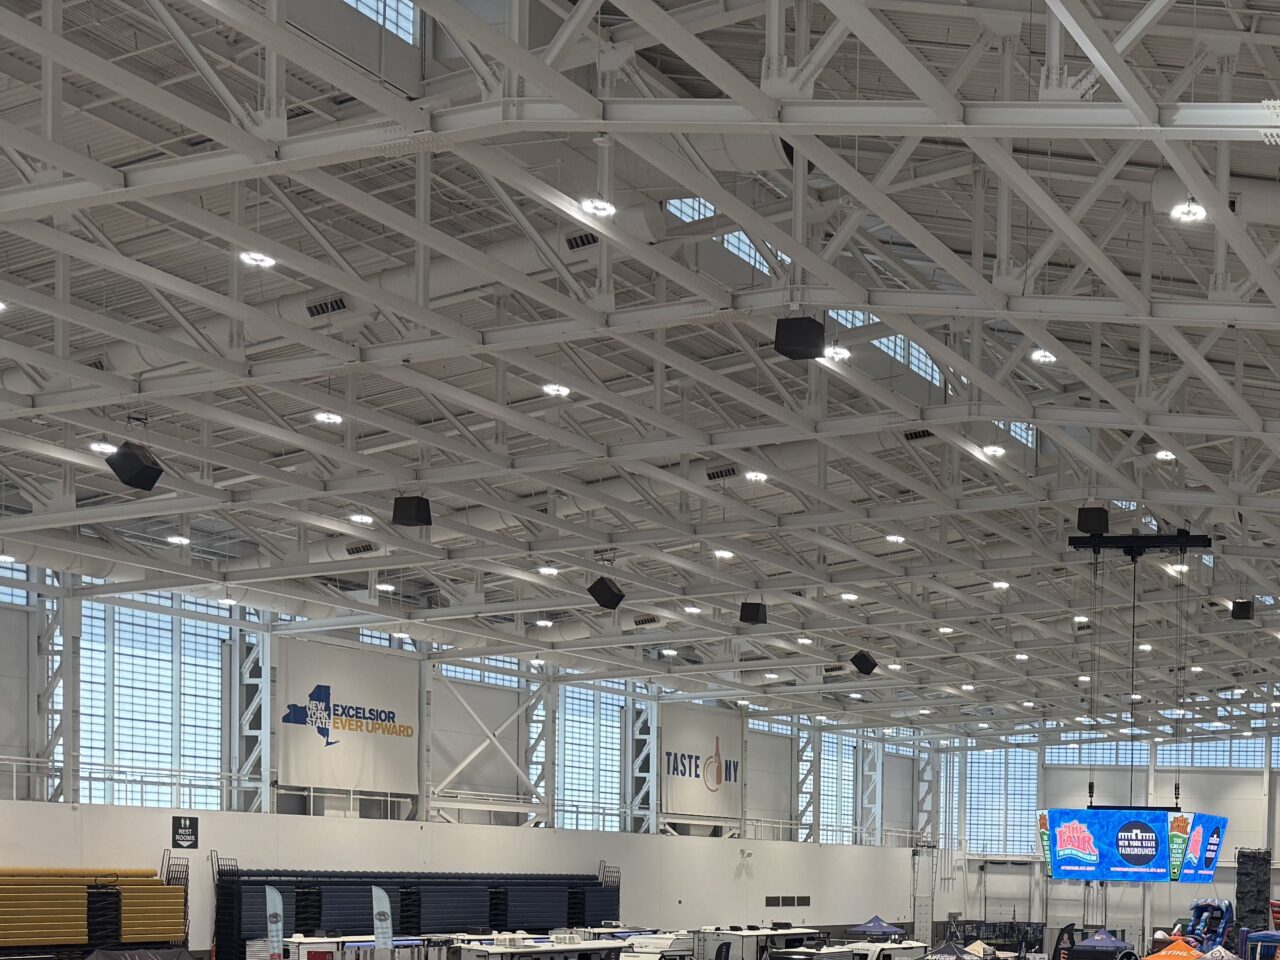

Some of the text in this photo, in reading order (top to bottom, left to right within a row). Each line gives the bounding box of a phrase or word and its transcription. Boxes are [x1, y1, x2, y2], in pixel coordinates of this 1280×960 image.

[307, 701, 325, 711] NEW
[307, 710, 329, 720] YORK
[333, 704, 396, 723] EXCELSIOR
[306, 718, 331, 728] STATE
[332, 717, 414, 737] EVER UPWARD
[665, 751, 739, 783] TASTE NY
[1056, 829, 1098, 855] FAIR
[1118, 847, 1156, 855] FAIRGROUNDS
[1160, 949, 1192, 957] STIHL
